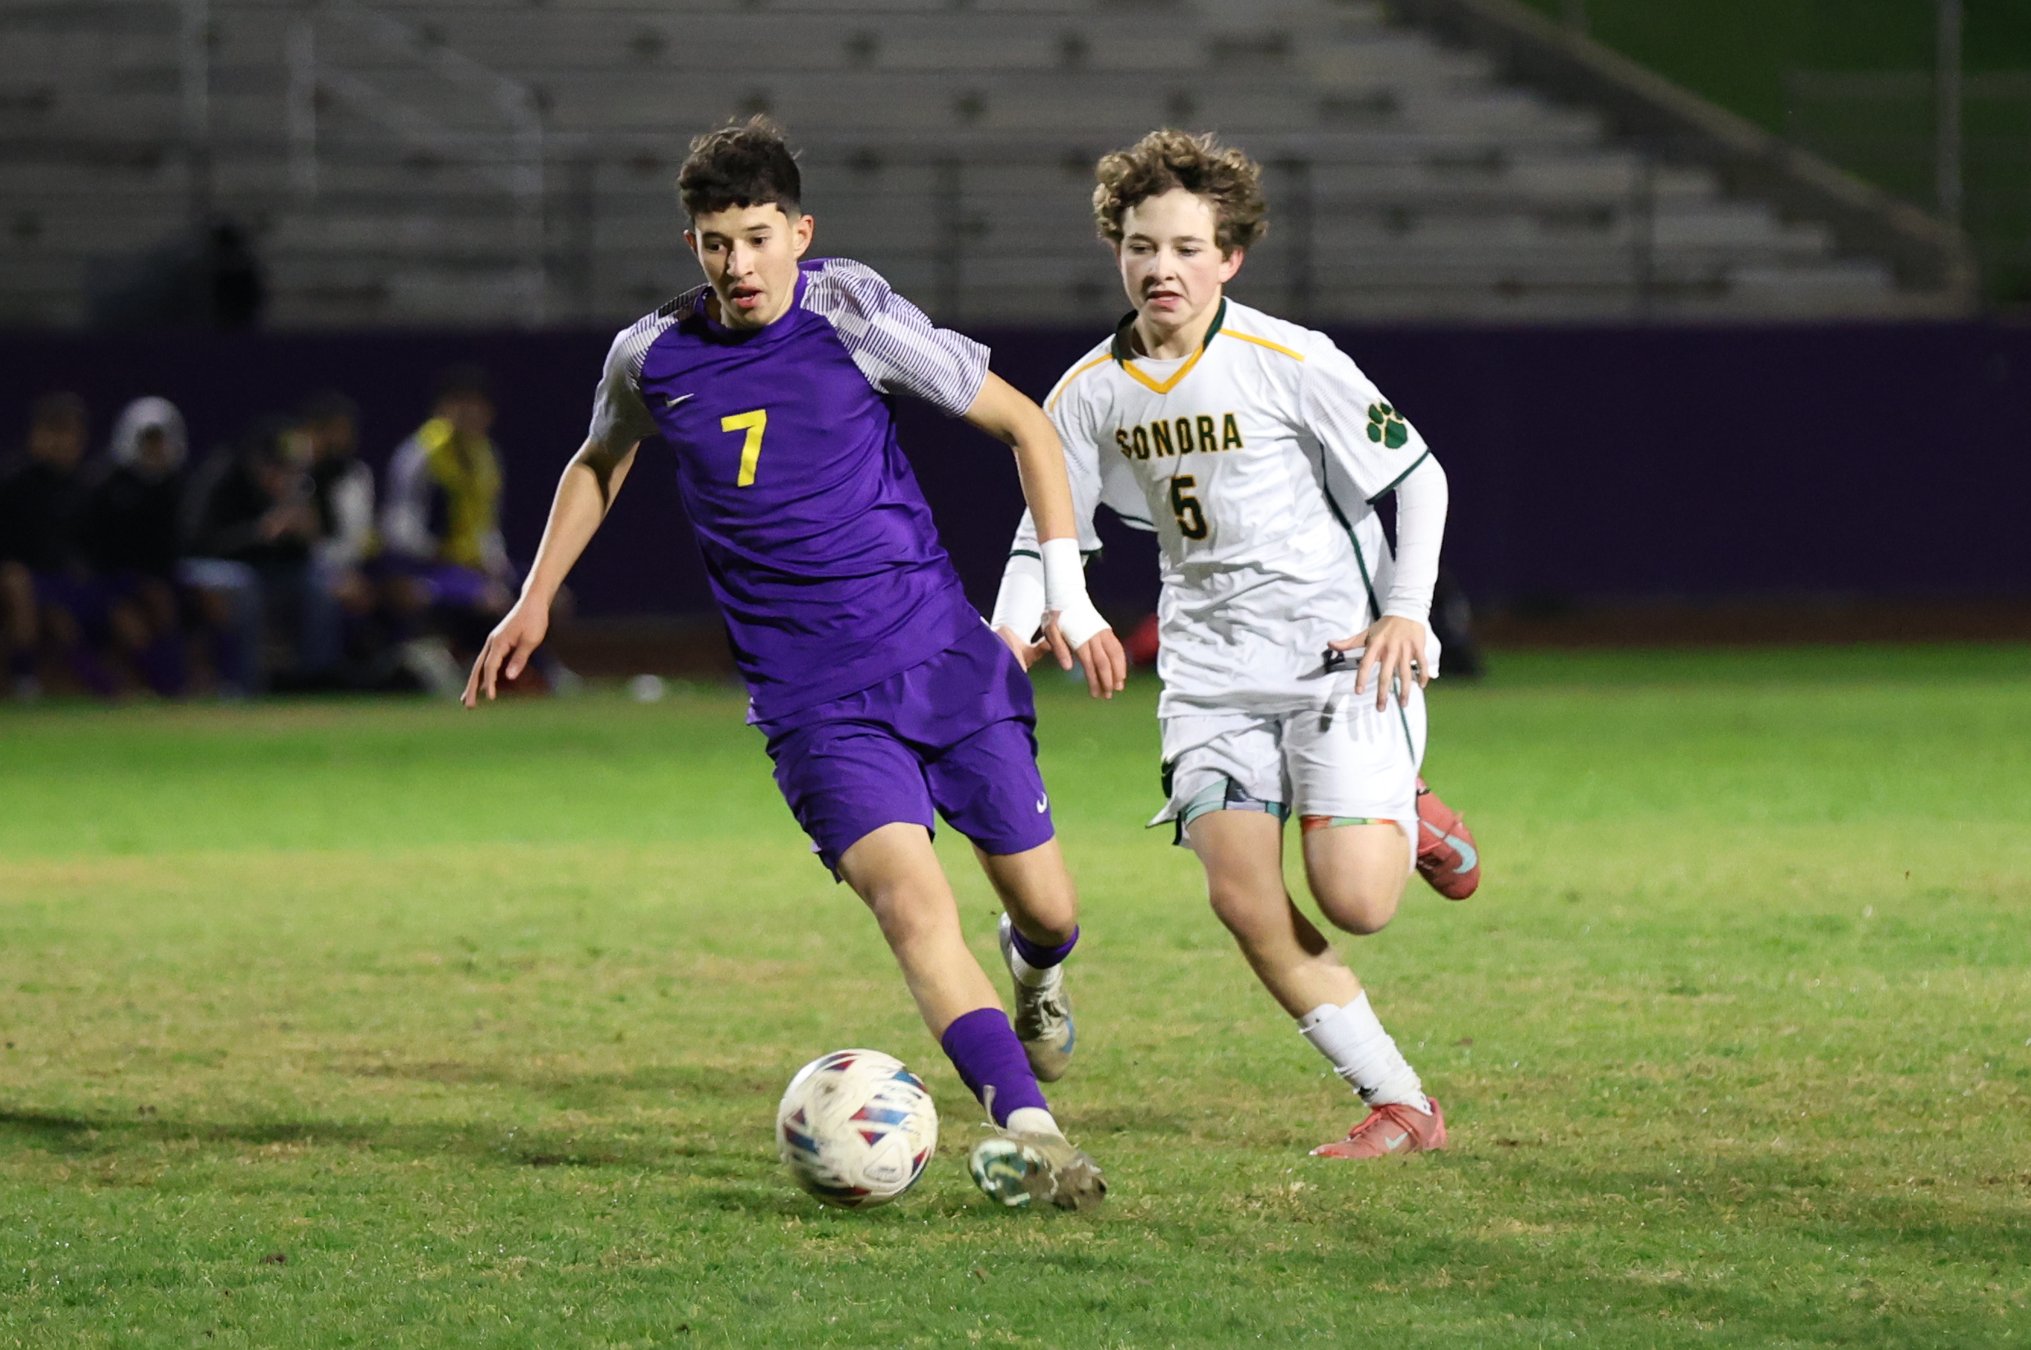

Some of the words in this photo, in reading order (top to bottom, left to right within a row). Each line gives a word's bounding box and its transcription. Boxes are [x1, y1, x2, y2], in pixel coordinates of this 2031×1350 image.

[720, 409, 767, 487] 7
[1115, 412, 1243, 460] SONORA
[1170, 474, 1208, 541] 5
